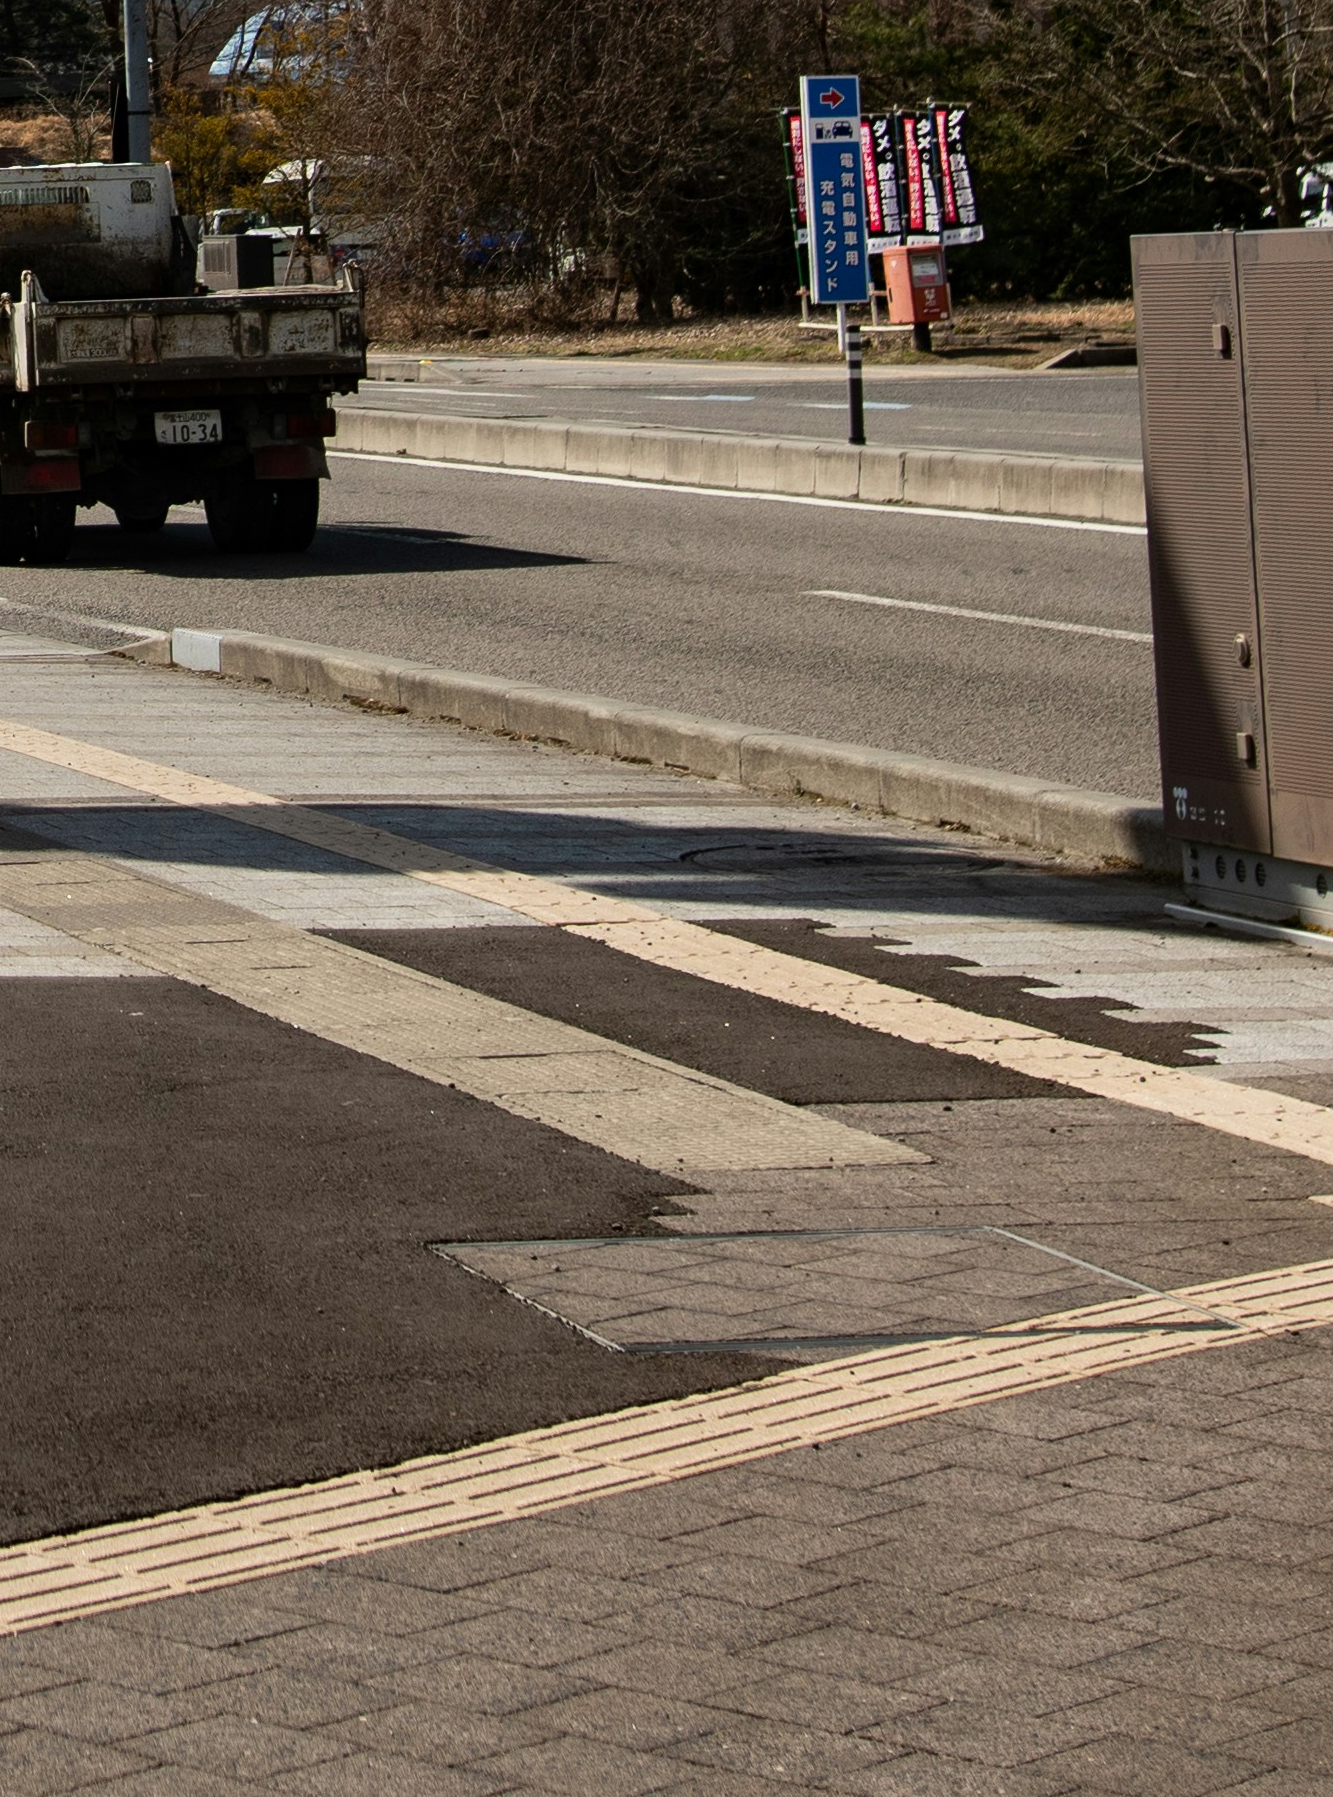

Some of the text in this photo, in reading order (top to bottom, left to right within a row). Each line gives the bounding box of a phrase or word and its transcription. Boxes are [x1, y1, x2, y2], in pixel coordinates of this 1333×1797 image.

[819, 180, 839, 294] 充電スタンド
[840, 152, 859, 267] 電気自動車用
[172, 423, 219, 443] 10-34
